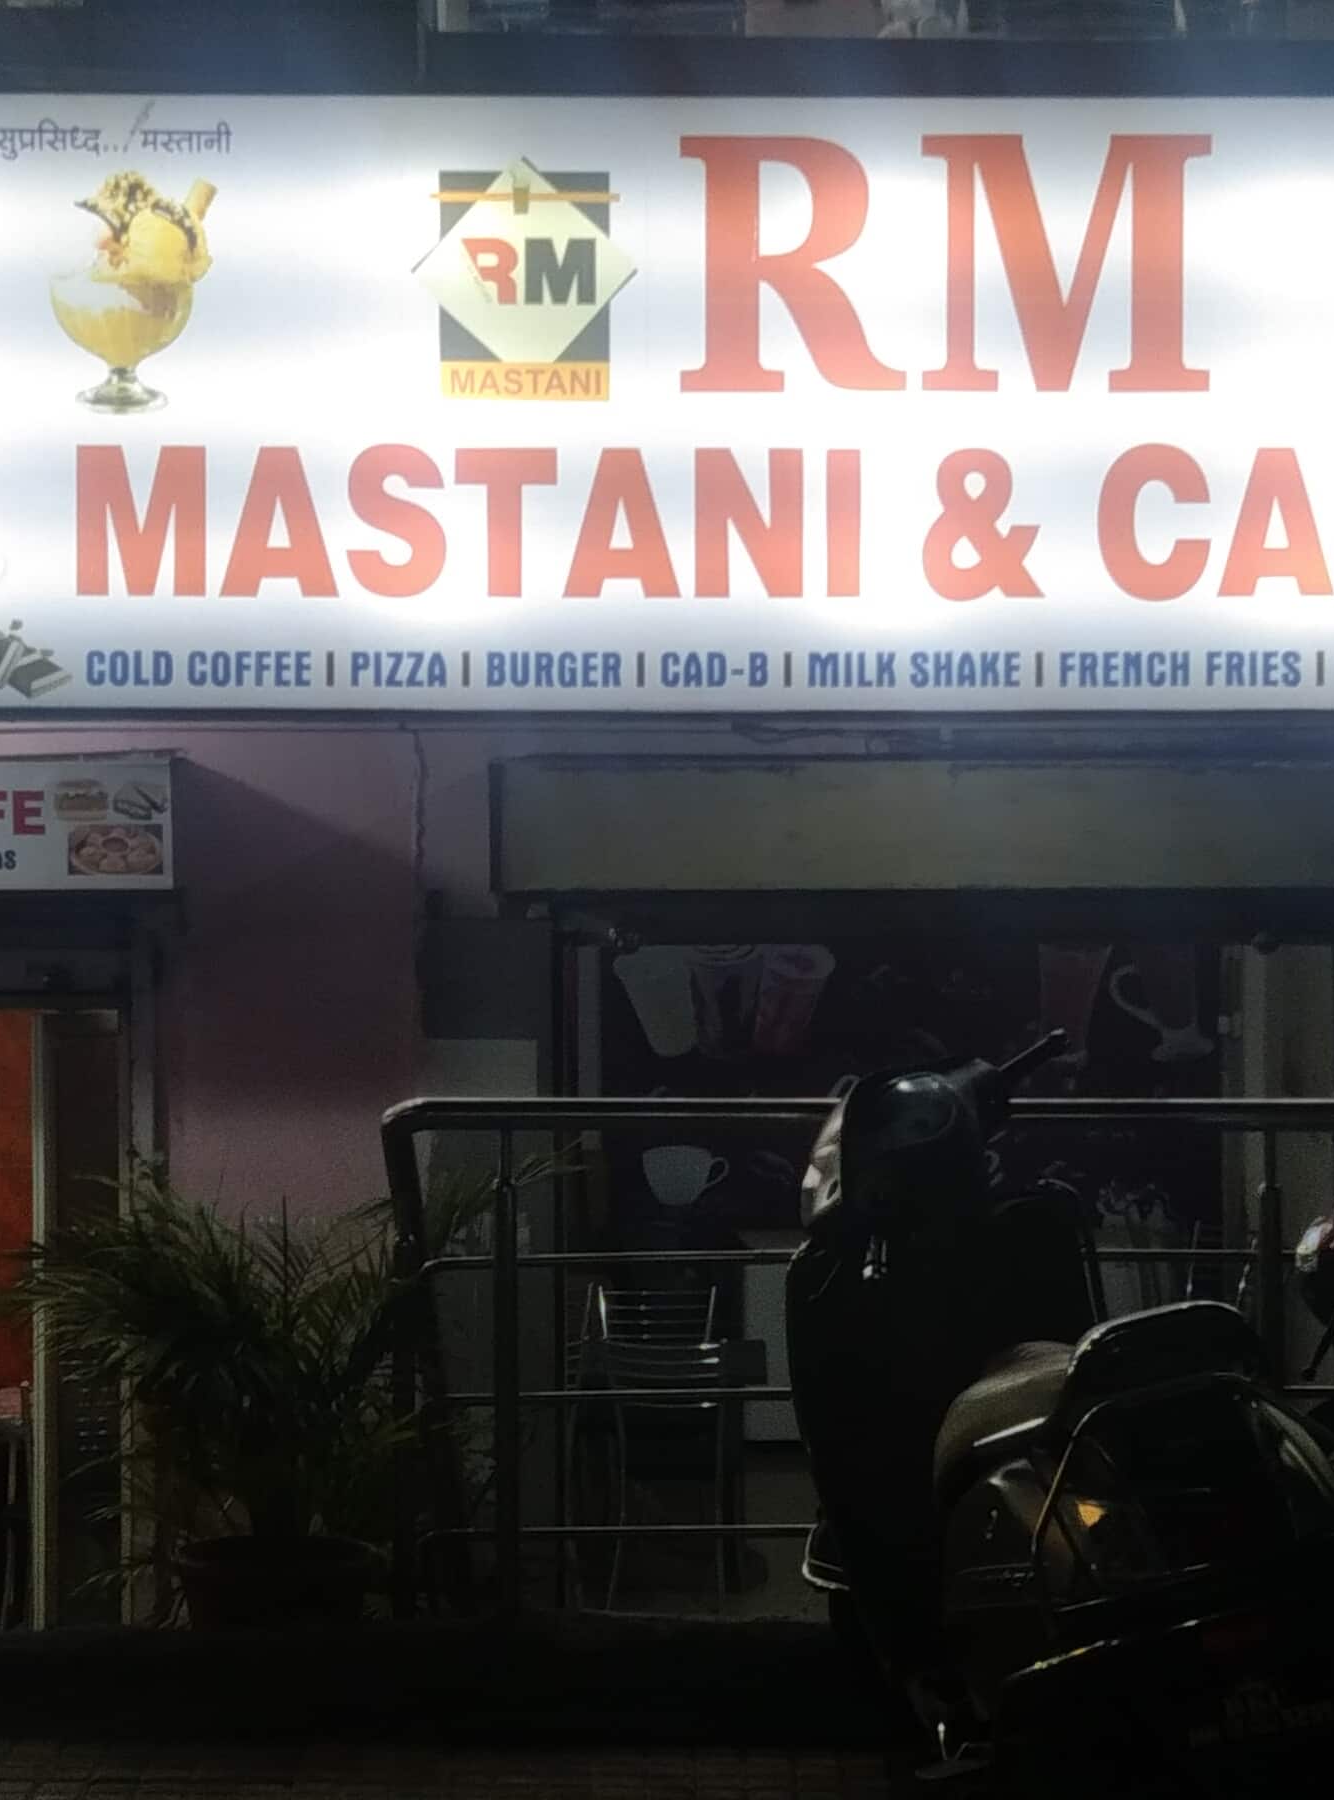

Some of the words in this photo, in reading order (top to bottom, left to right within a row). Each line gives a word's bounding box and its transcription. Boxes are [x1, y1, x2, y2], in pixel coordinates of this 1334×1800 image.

[140, 119, 232, 154] मस्तानी
[461, 237, 596, 305] RM
[679, 134, 1214, 392] RM
[449, 368, 602, 396] MASTANI
[75, 444, 862, 600] MASTANI
[922, 447, 1045, 602] &
[85, 650, 174, 688] COLD
[186, 650, 312, 688] COFFEE
[349, 650, 448, 688] PIZZA
[486, 650, 623, 688] BURGER
[659, 651, 769, 688] CAD-B
[806, 651, 897, 688] MILK
[909, 651, 1022, 688] SHAKE
[1058, 650, 1191, 688] FRENCH
[1204, 650, 1302, 688] FRIES
